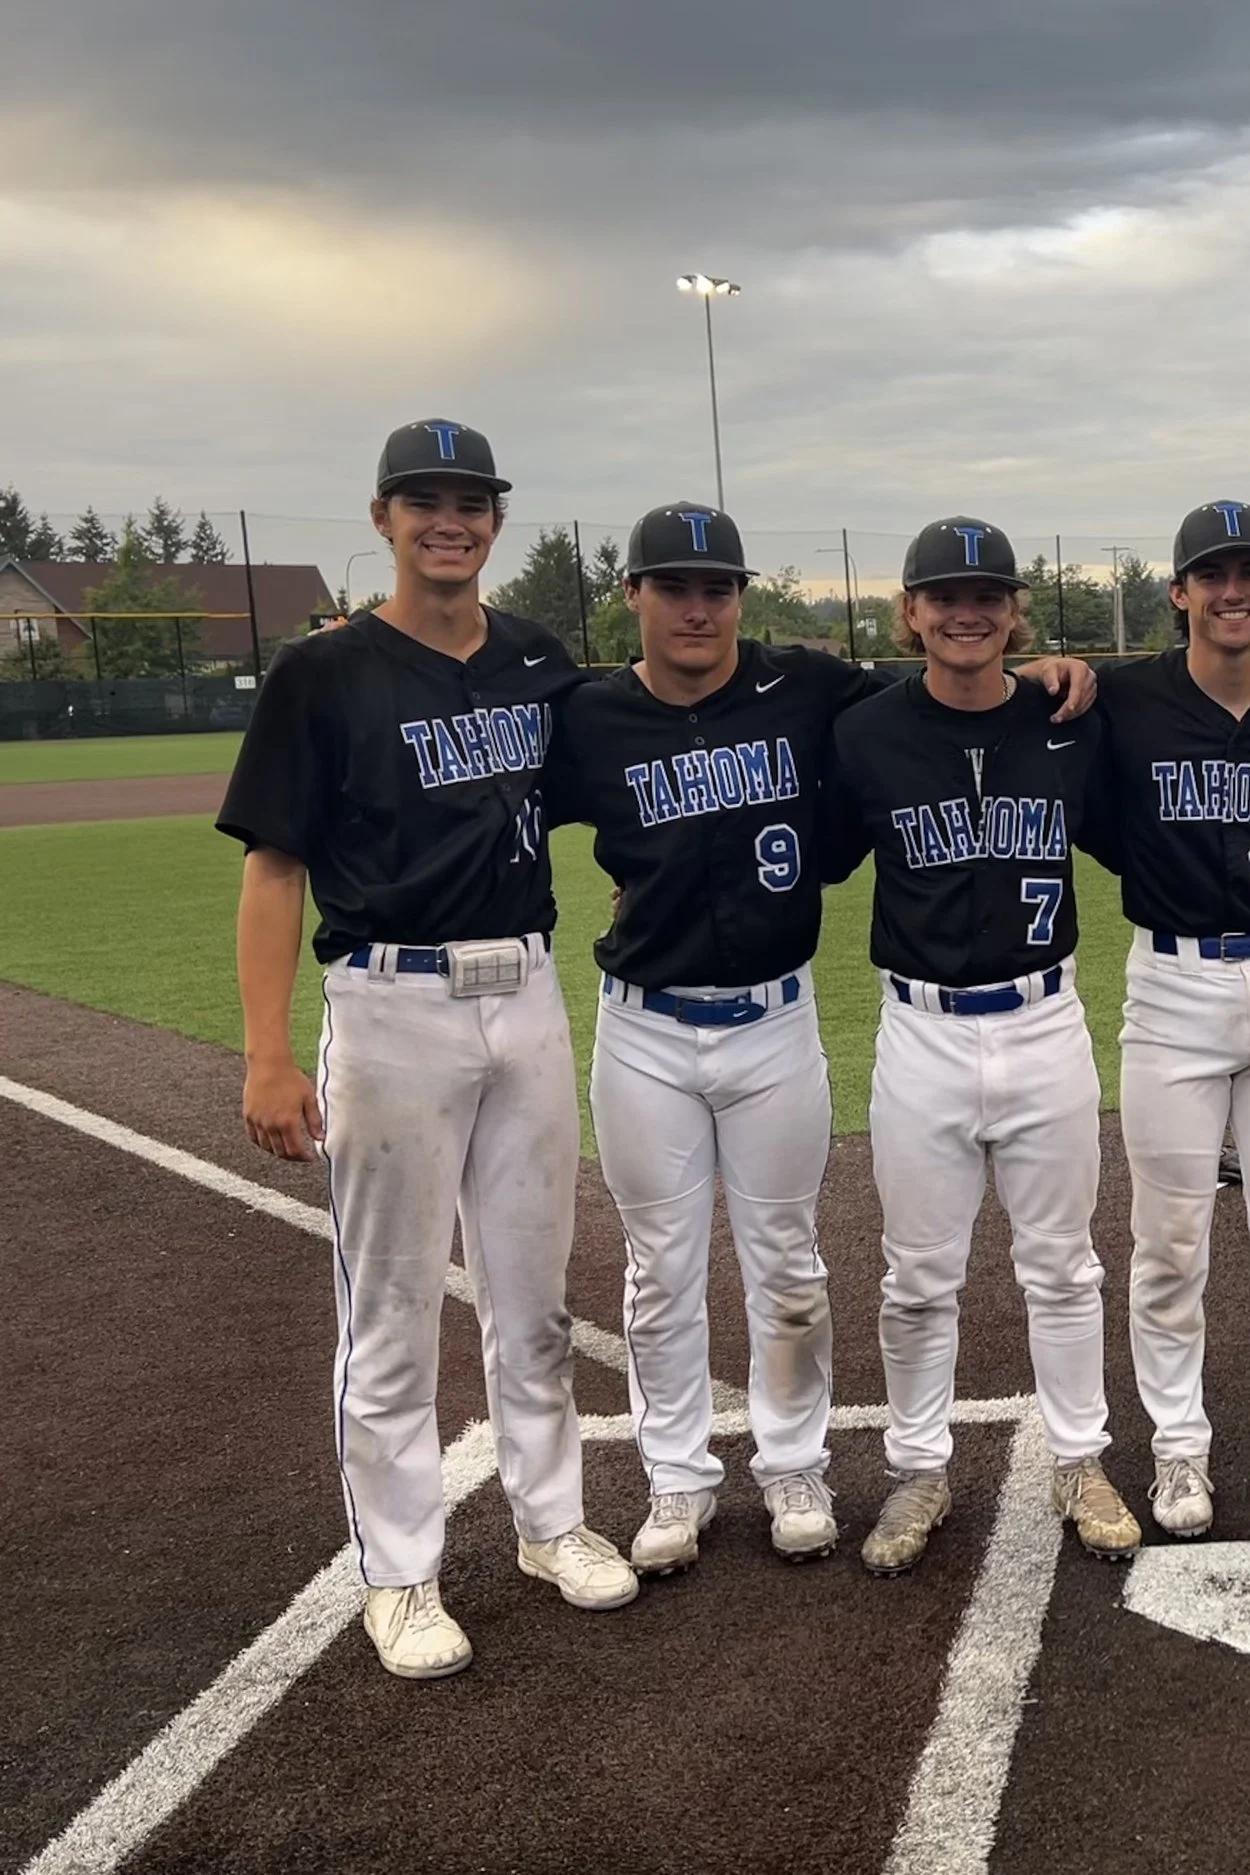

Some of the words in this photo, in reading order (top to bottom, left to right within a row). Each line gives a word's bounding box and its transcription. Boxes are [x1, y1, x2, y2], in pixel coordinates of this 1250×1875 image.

[424, 423, 459, 460] T
[678, 511, 711, 552] T
[953, 526, 984, 566] T
[1212, 503, 1242, 537] T
[624, 737, 800, 828] TAHOMA
[754, 823, 801, 892] 9
[891, 796, 1067, 869] TAHOMA
[1020, 877, 1064, 945] 7
